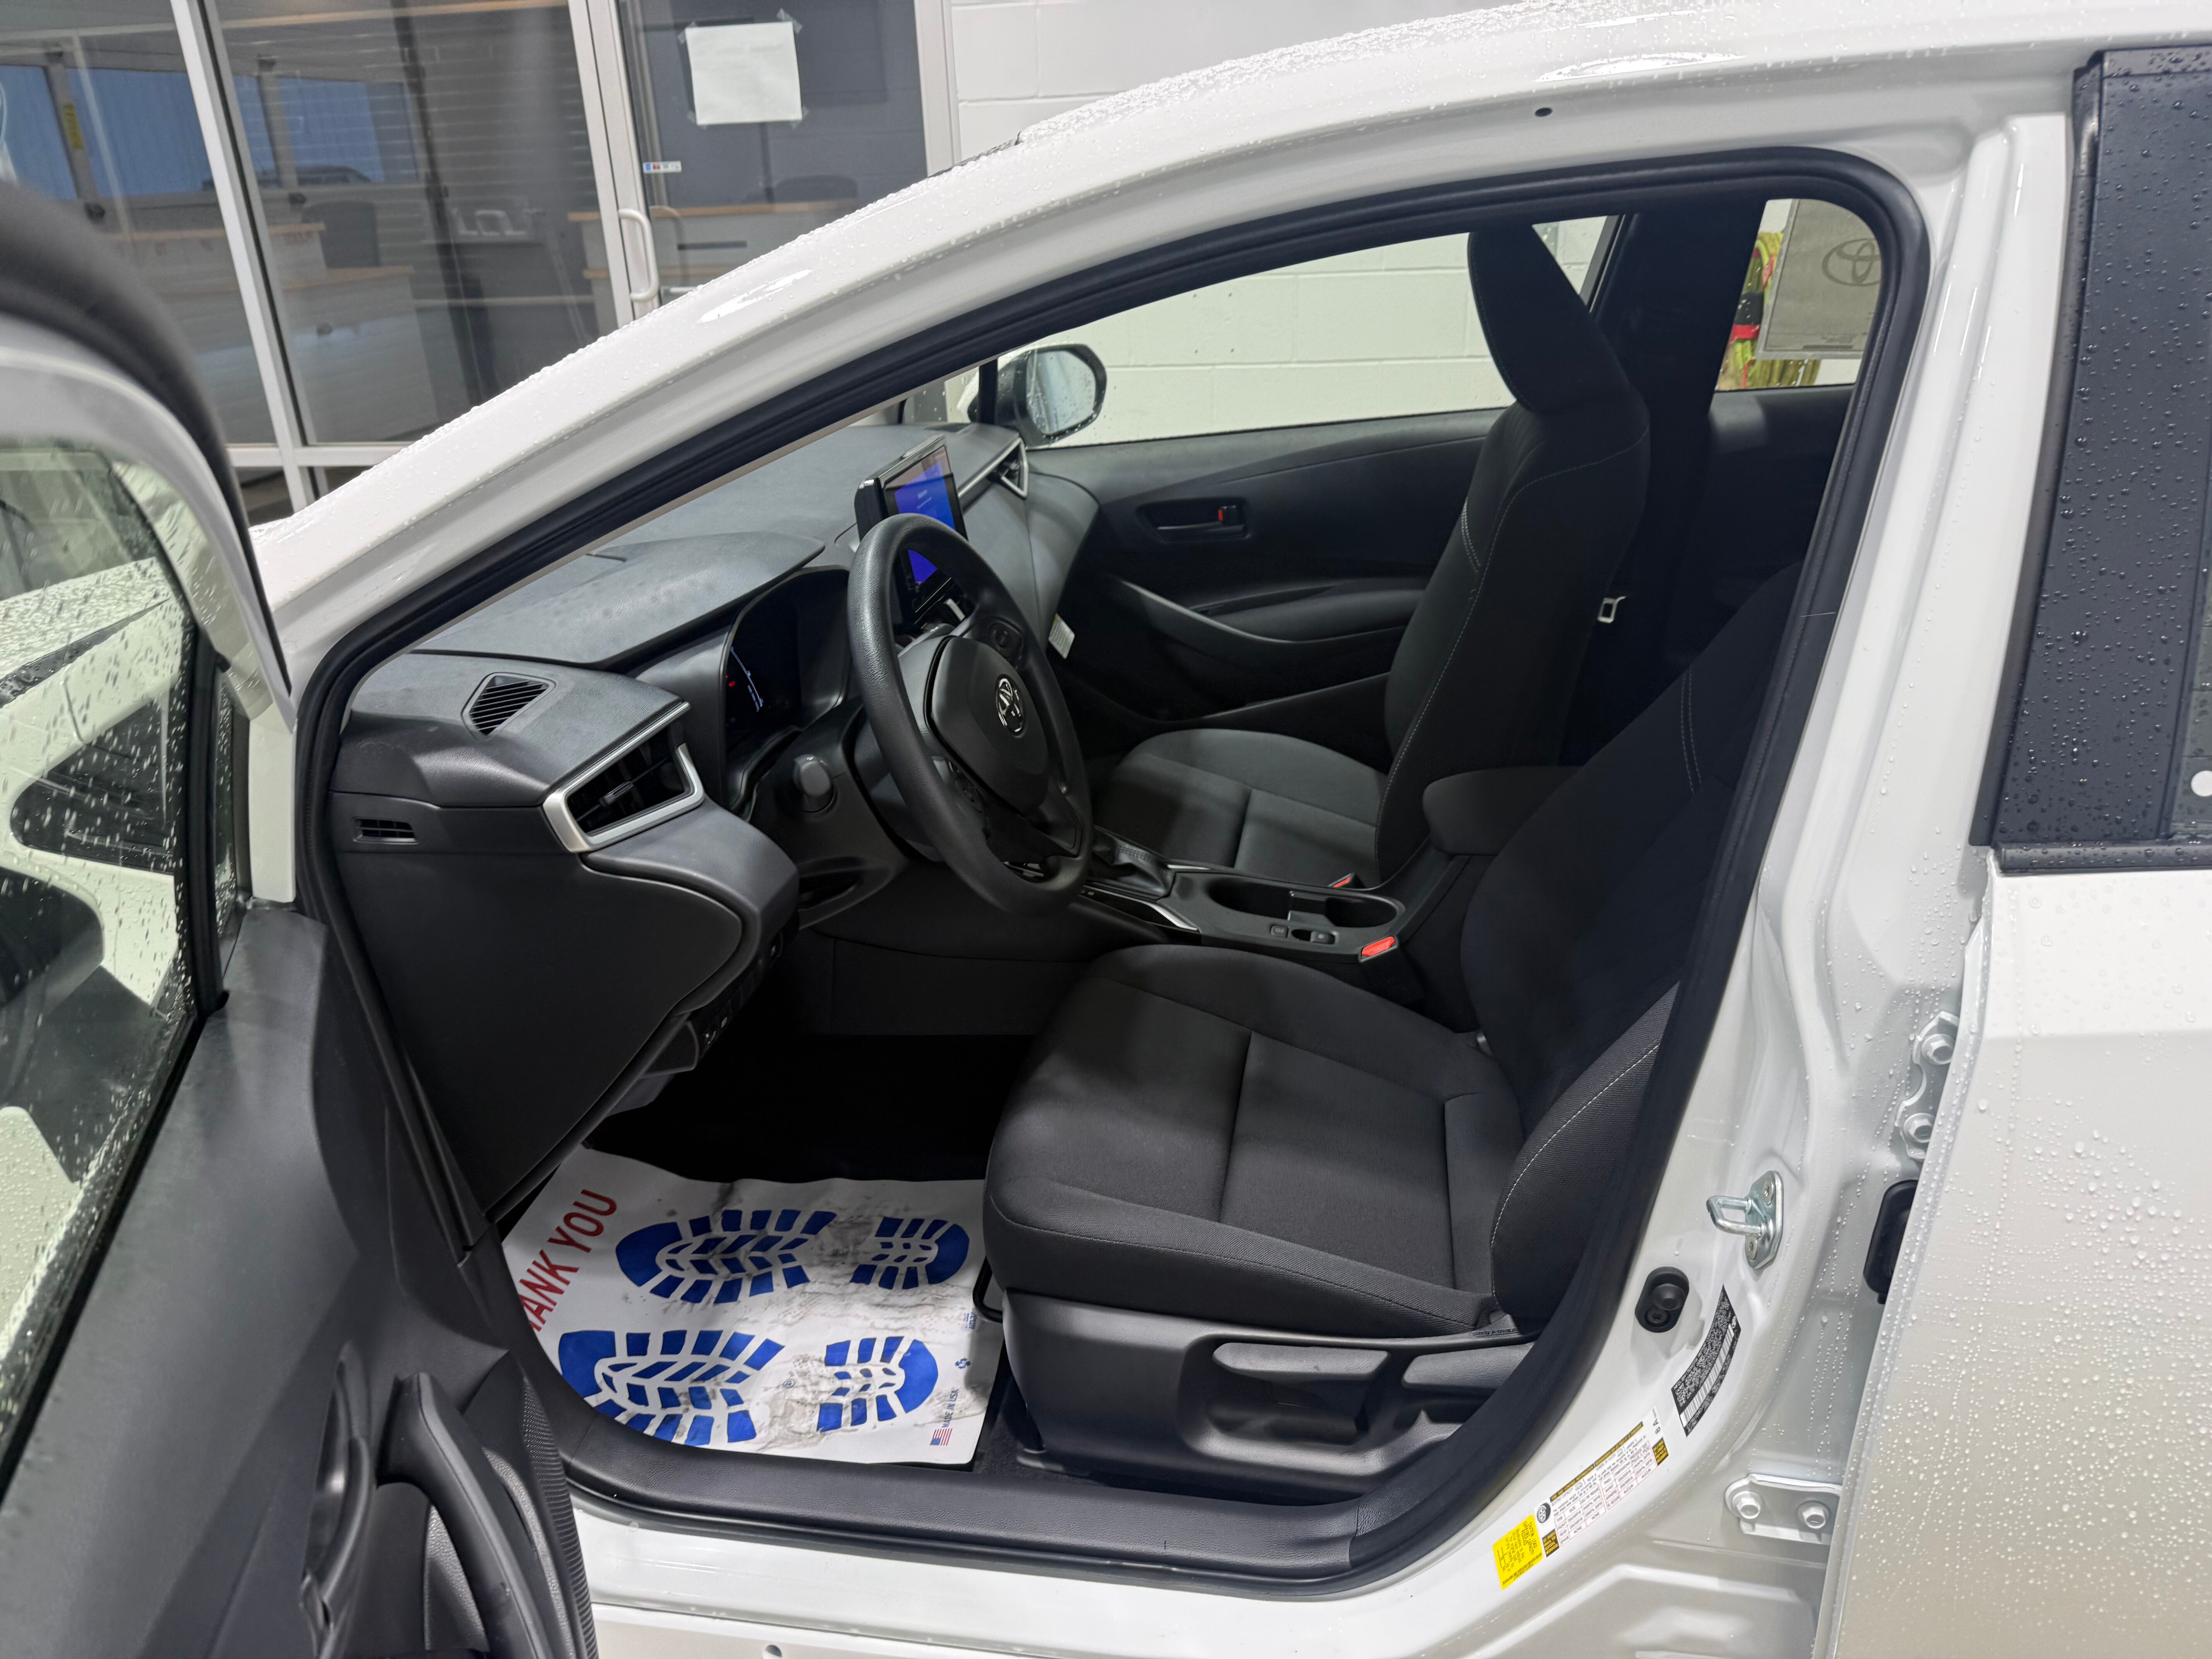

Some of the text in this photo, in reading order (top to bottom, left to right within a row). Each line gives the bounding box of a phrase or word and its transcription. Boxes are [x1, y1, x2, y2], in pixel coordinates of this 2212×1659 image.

[519, 1189, 617, 1332] ANK YOU
[941, 1412, 954, 1428] MADE
[950, 1388, 959, 1402] USA
